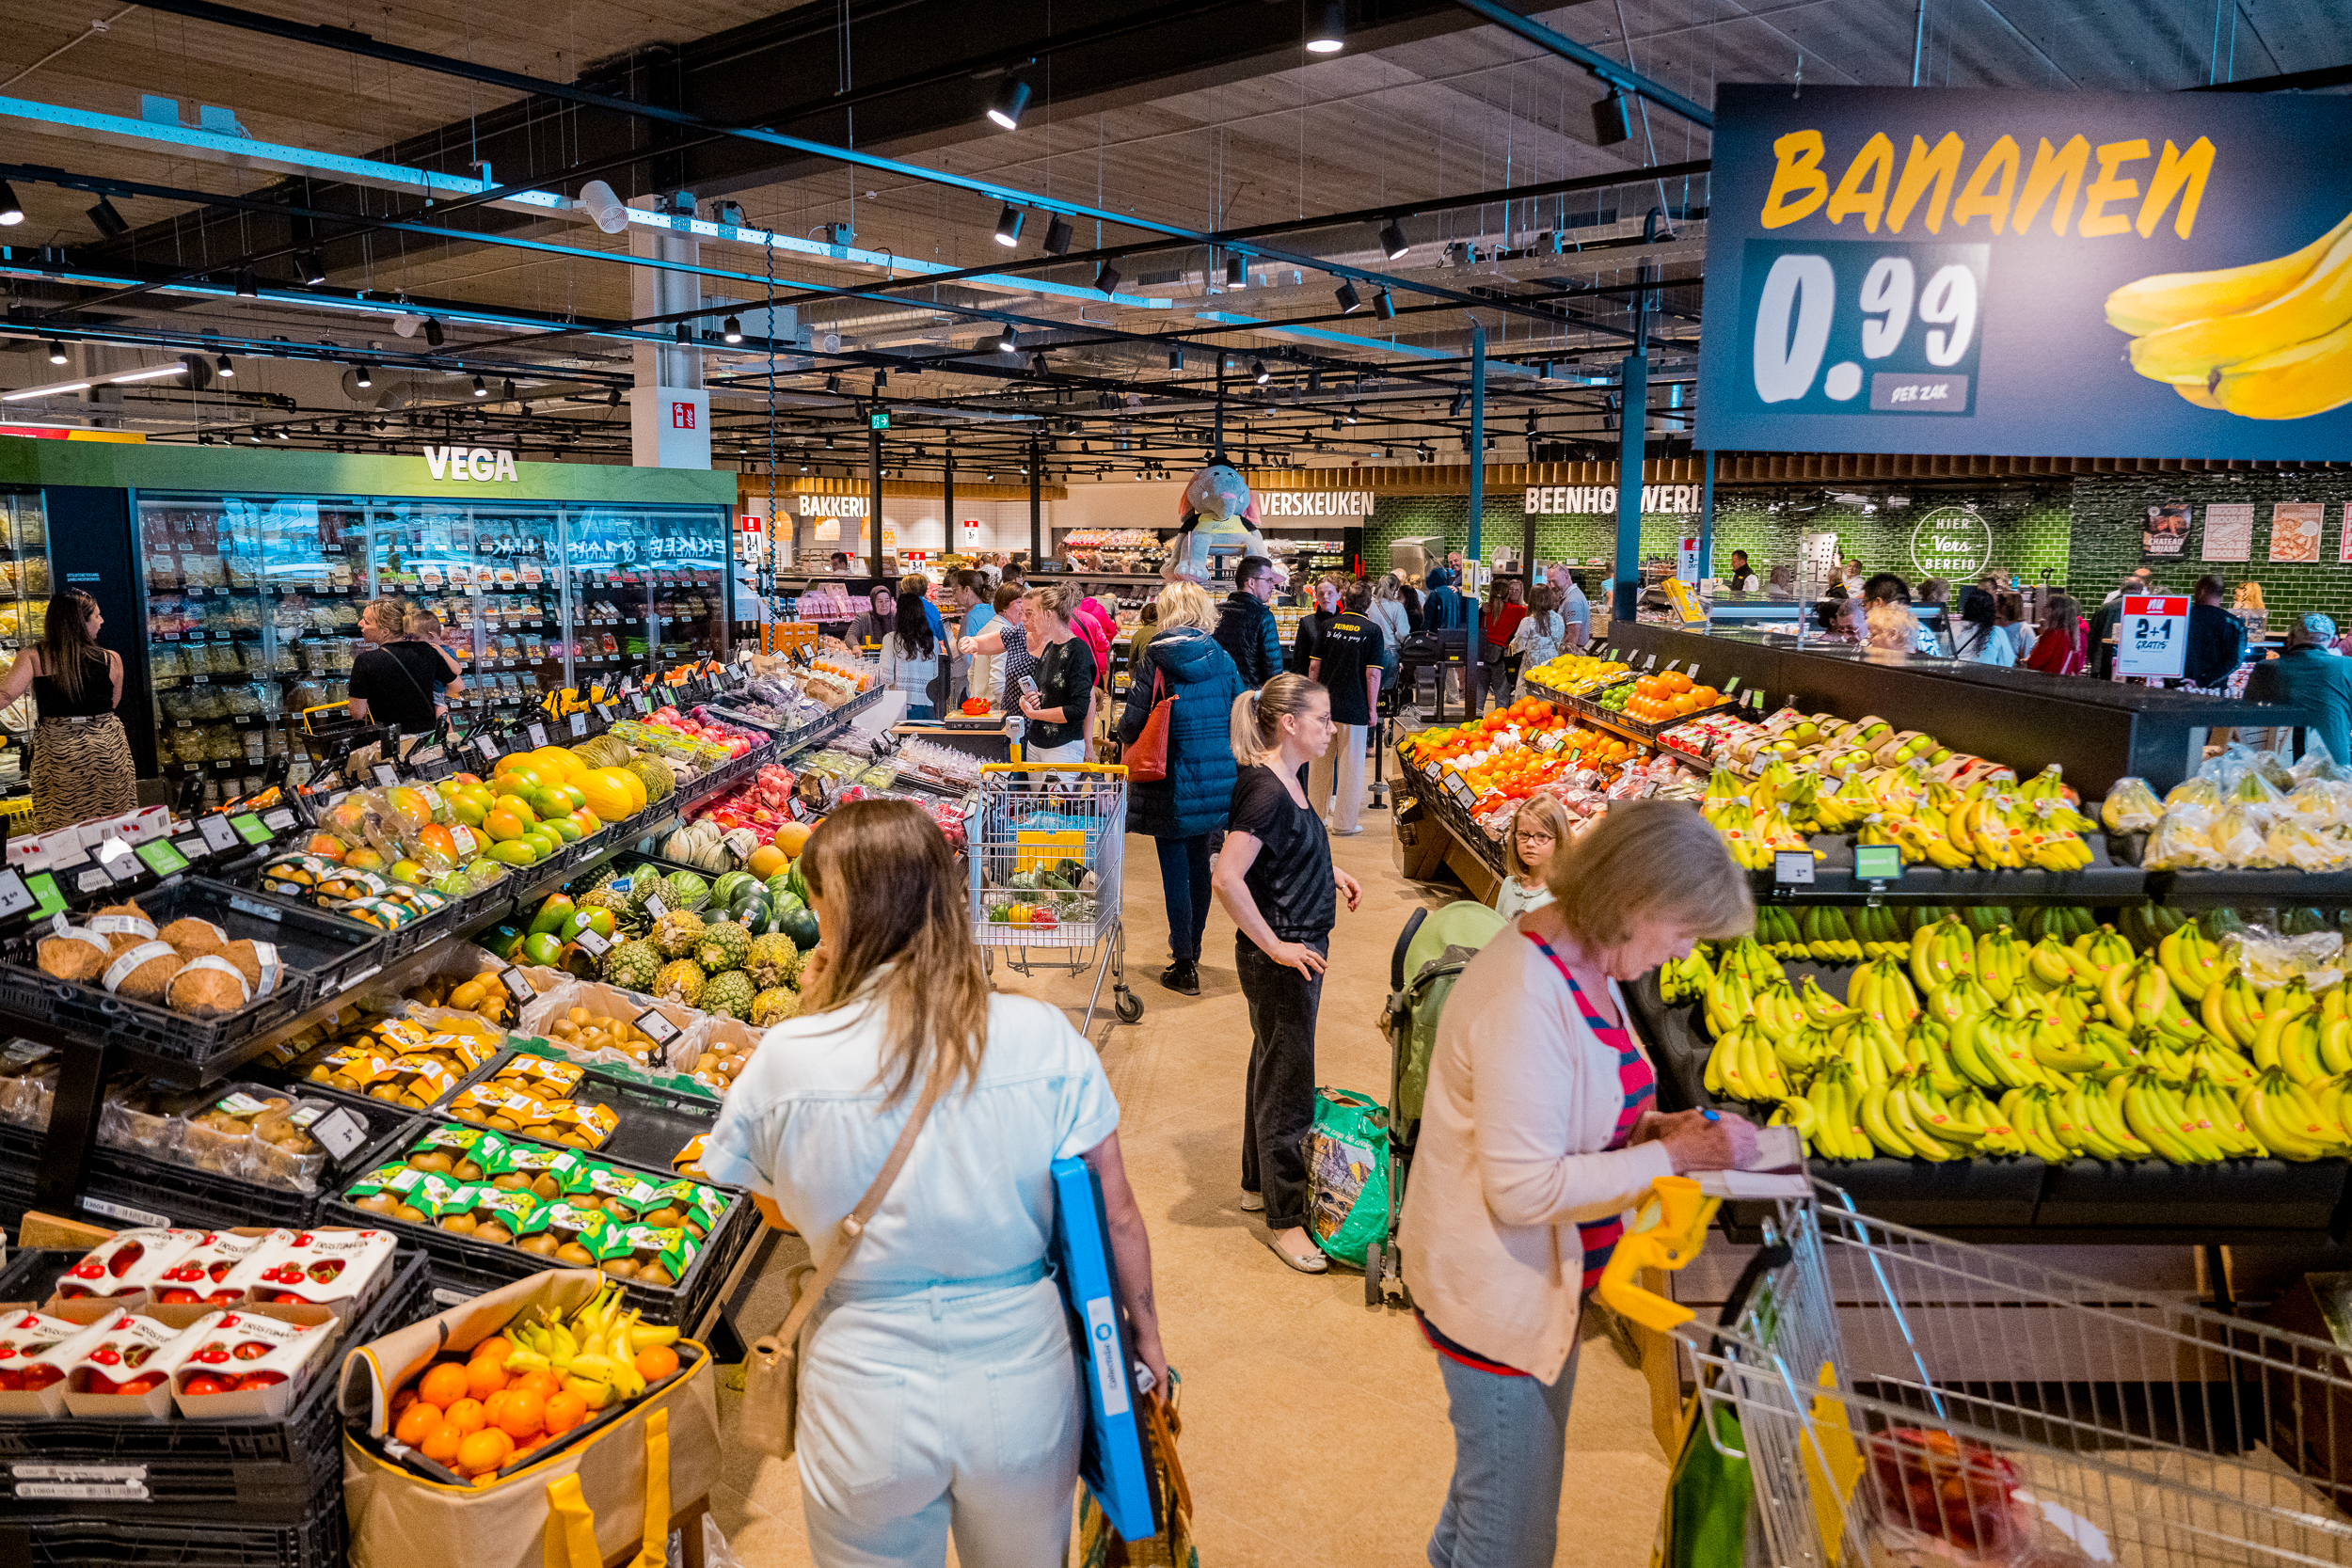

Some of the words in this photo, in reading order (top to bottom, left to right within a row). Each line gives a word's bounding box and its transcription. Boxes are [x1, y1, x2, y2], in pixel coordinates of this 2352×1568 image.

[1760, 129, 2217, 240] BANANEN
[1753, 254, 1978, 404] 0.99
[1891, 385, 1919, 404] PER
[1919, 383, 1948, 401] ZAK
[422, 446, 518, 482] VEGA
[799, 495, 870, 518] BAKKERIJ
[1259, 491, 1375, 516] VERSKEUKEN
[1524, 484, 1702, 515] BEENHOWERI
[1935, 518, 1970, 530] HIER
[1931, 534, 1973, 552] Vers
[1925, 558, 1976, 570] BEREID
[1332, 623, 1361, 632] JUMBO
[2135, 618, 2172, 640] 2+1
